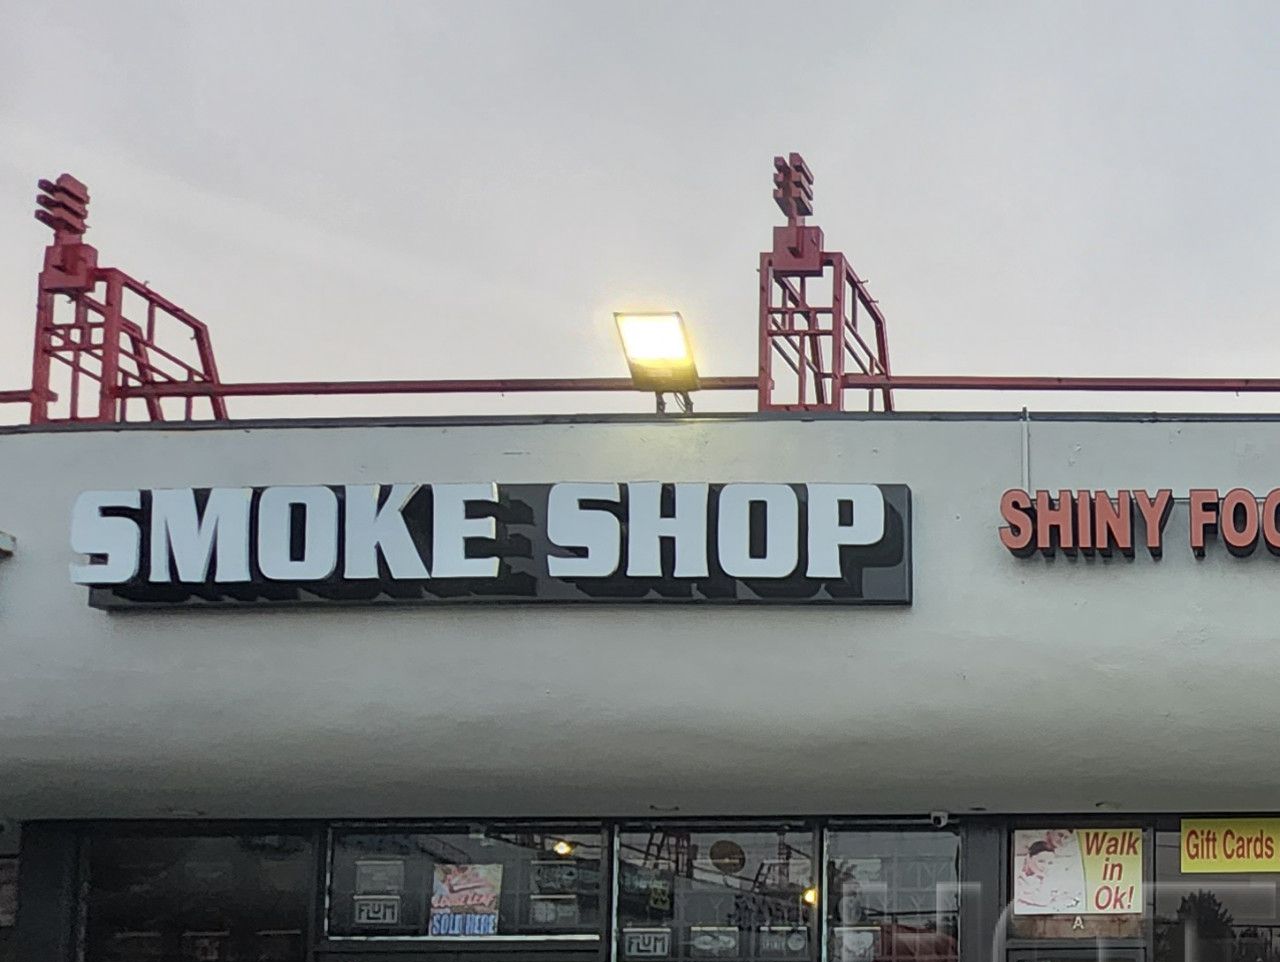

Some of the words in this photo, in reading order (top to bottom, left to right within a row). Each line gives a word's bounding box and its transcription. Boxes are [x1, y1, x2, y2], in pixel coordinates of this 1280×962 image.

[69, 482, 500, 585] SMOKE
[546, 482, 886, 579] SHOP
[999, 488, 1171, 555] SHINY
[1084, 831, 1141, 857] Walk
[1185, 828, 1218, 860] Gift
[1222, 828, 1275, 860] Cards
[1102, 857, 1123, 882] in
[1094, 885, 1135, 911] Ok!
[431, 913, 464, 935] SOLD
[465, 913, 497, 935] HERE
[1073, 916, 1085, 930] A
[627, 935, 667, 954] FLUM
